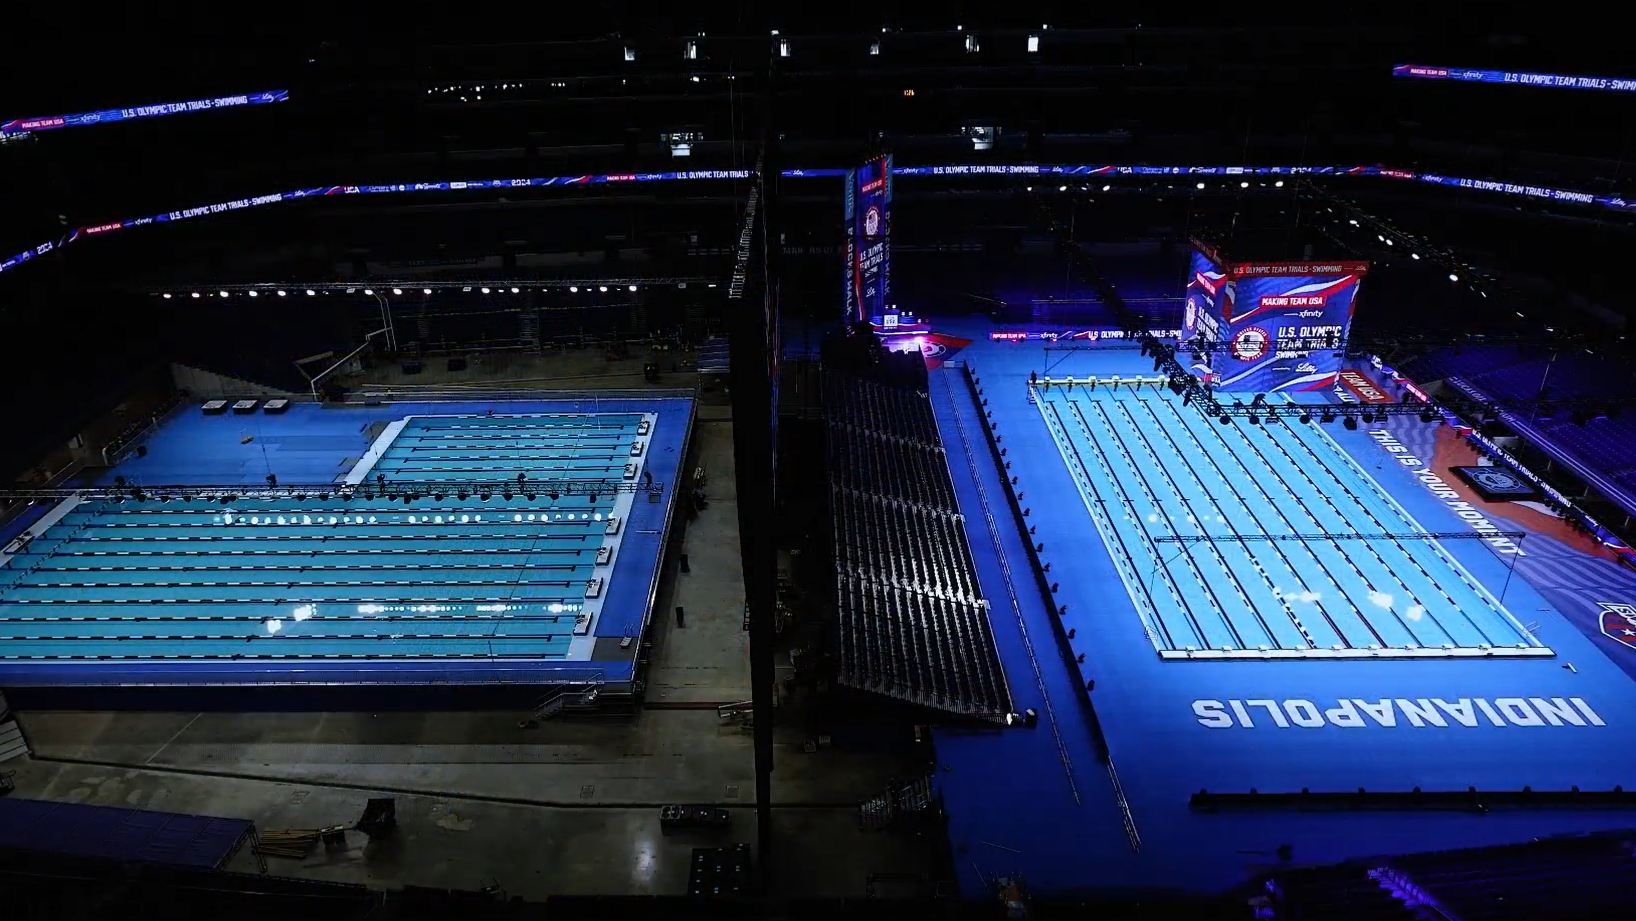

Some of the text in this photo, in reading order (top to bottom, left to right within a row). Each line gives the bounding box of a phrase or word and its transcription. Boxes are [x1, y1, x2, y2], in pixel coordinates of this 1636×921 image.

[1504, 73, 1519, 83] U.S.
[1520, 74, 1553, 85] OLYMPIC
[1555, 76, 1576, 87] TEAM
[1577, 78, 1606, 88] TRIALS
[121, 108, 136, 118] U.S.
[137, 104, 167, 117] OLYMPIC
[167, 102, 187, 113] TEAM
[188, 99, 212, 111] TRIALS
[215, 95, 248, 108] SWIMMING
[676, 171, 688, 180] U.S.
[713, 170, 729, 179] TEAM
[729, 170, 749, 178] TRIALS
[933, 165, 944, 174] U.S.
[945, 165, 969, 174] OLYMPIC
[969, 165, 986, 173] TEAM
[986, 165, 1006, 173] TRIALS
[1009, 165, 1039, 173] SWIMMING
[1460, 178, 1473, 188] U.S.
[1474, 180, 1503, 192] OLYMPIC
[1504, 183, 1524, 194] TEAM
[1525, 186, 1550, 198] TRIALS
[1554, 190, 1594, 203] SWIMMING
[169, 211, 182, 221] U.S.
[183, 205, 210, 218] OLYMPIC
[209, 203, 228, 213] TEAM
[228, 198, 249, 210] TRIALS
[251, 193, 282, 206] SWIMMING
[1245, 266, 1271, 274] OLYMPIC
[1271, 266, 1288, 274] TEAM
[1288, 265, 1309, 273] TRIALS
[1312, 265, 1343, 273] SWIMMING
[1261, 296, 1323, 306] MAKING TEAM USA
[1298, 310, 1323, 320] xfinity
[1278, 326, 1297, 338] U.S.
[1358, 386, 1385, 400] USA
[1368, 429, 1408, 454] THIS
[1396, 455, 1423, 467] IS
[1412, 468, 1460, 499] YOUR
[1191, 697, 1607, 728] INDIANAPOLIS
